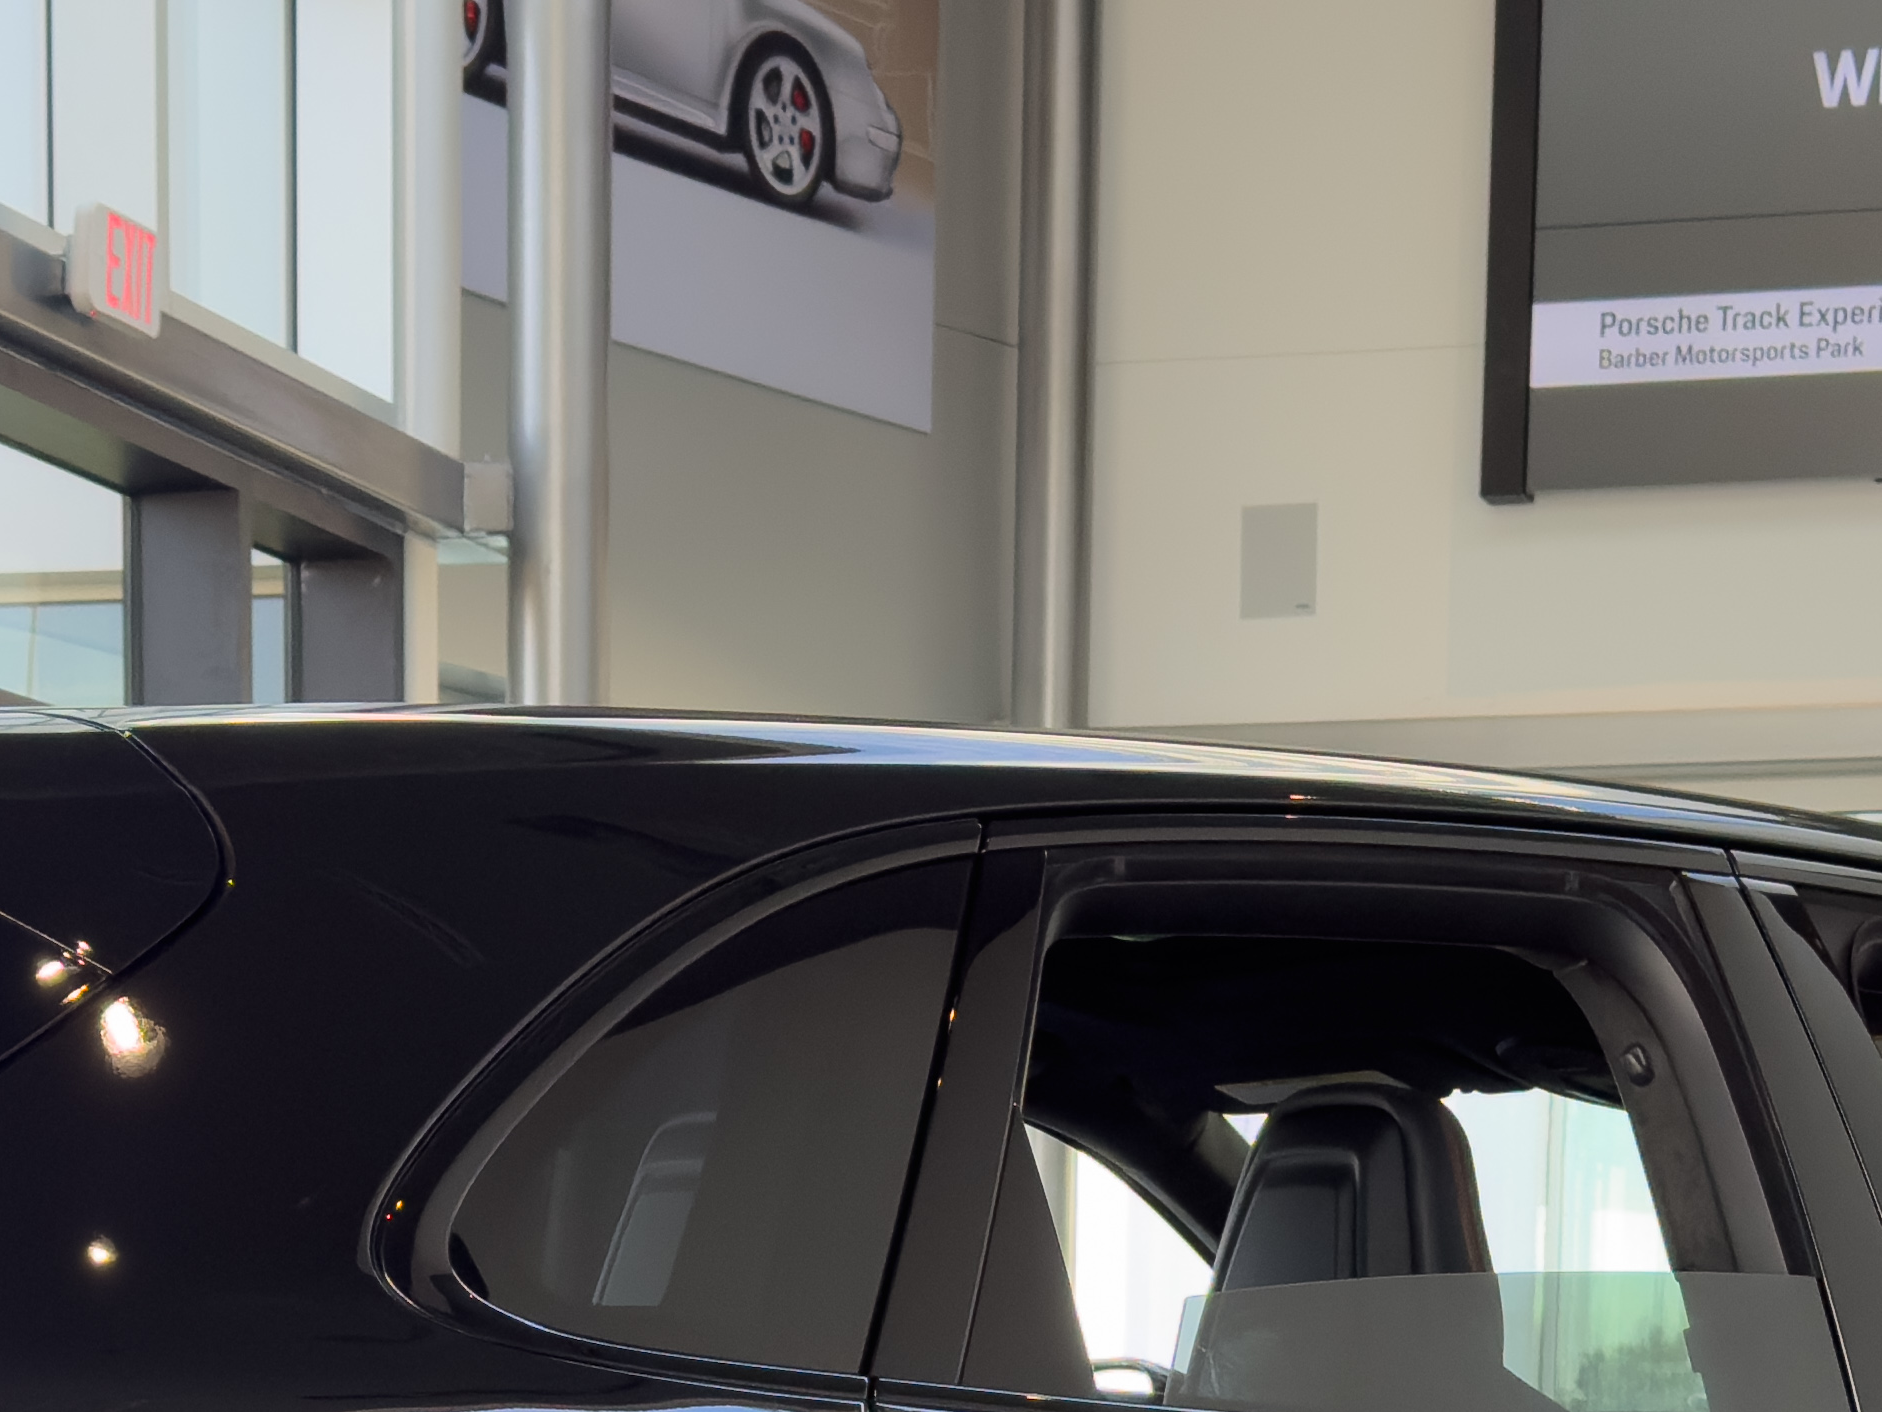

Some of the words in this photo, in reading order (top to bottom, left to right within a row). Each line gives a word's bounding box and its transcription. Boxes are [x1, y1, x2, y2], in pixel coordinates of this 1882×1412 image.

[106, 210, 158, 326] EXIT
[1599, 307, 1710, 339] Porsche
[1716, 302, 1790, 332] Track
[1598, 347, 1670, 370] Barber
[1674, 339, 1810, 368] Motorsports
[1816, 335, 1865, 360] Park
